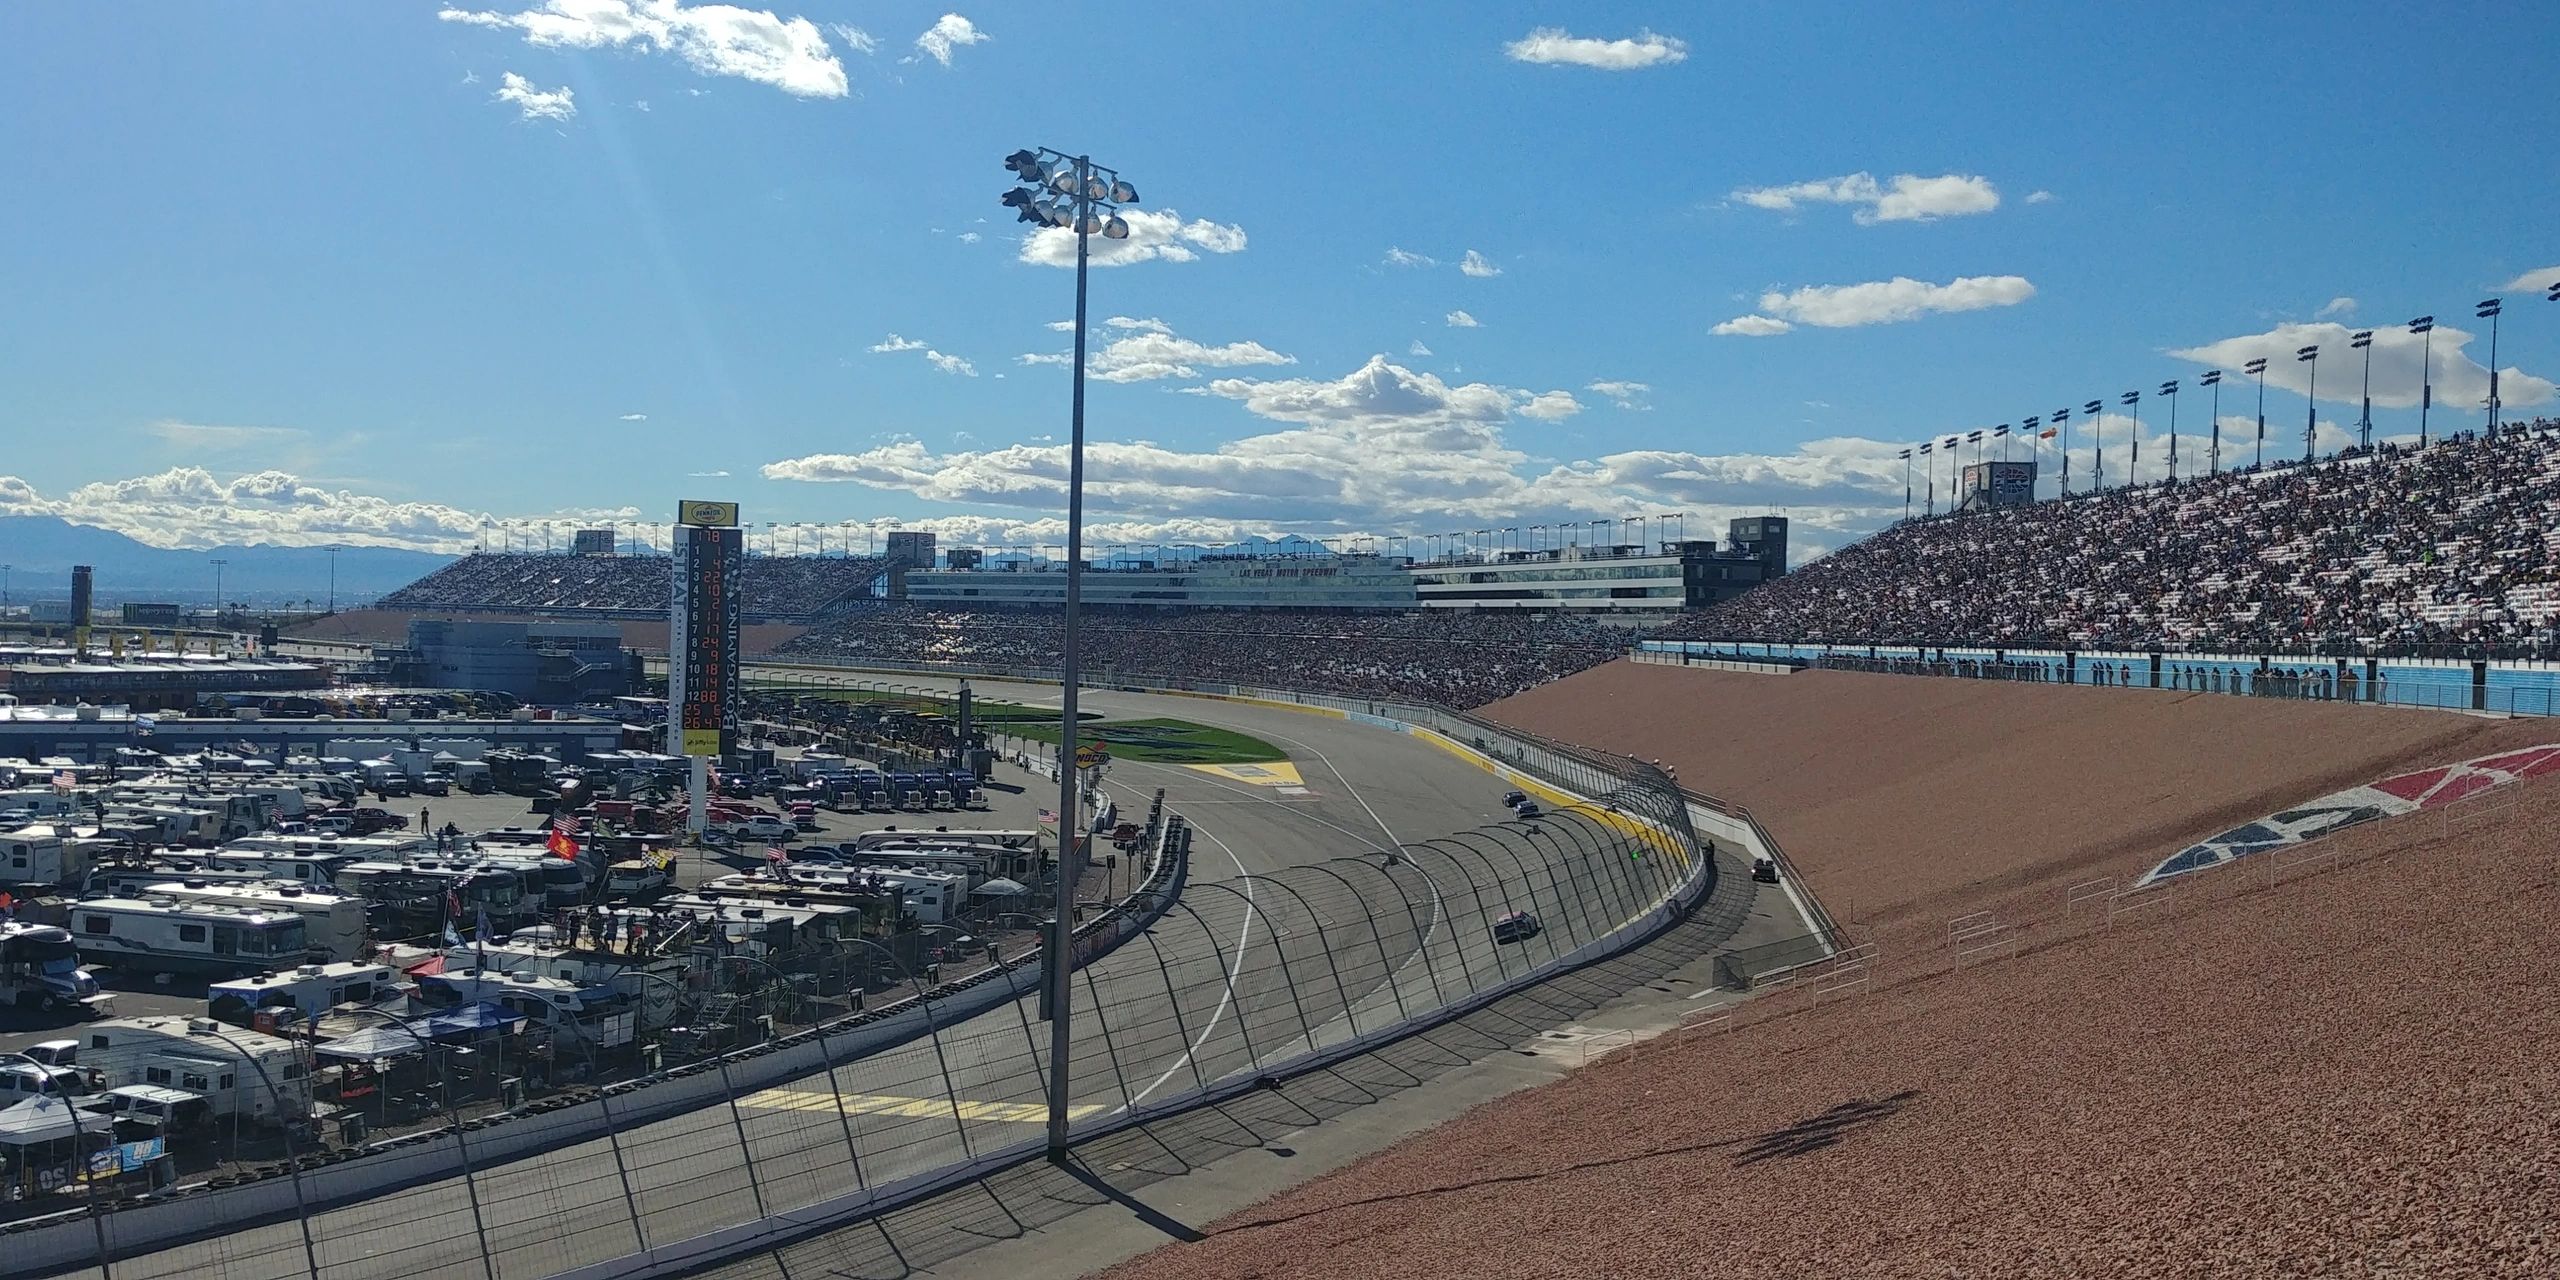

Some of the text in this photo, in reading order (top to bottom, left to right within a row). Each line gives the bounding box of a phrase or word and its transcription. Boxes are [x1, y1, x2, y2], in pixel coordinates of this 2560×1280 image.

[699, 530, 720, 542] 178
[694, 546, 721, 556] 1 1
[694, 559, 720, 569] 2 4
[694, 571, 720, 582] 3 22
[1239, 568, 1338, 577] LAS VEGAS MOTOR SPEEDWAY
[673, 548, 688, 611] STRAT
[693, 584, 720, 596] 4 10
[693, 598, 720, 610] 5 2
[692, 611, 720, 621] 6 11
[692, 625, 720, 634] 7 17
[692, 637, 719, 648] 8 24
[691, 650, 718, 662] 9 9
[688, 664, 718, 675] 10 18
[688, 678, 718, 688] 11 14
[688, 691, 717, 702] 12 88
[684, 704, 720, 716] 25 6
[684, 717, 721, 728] 26 47
[1076, 754, 1106, 762] NOCO
